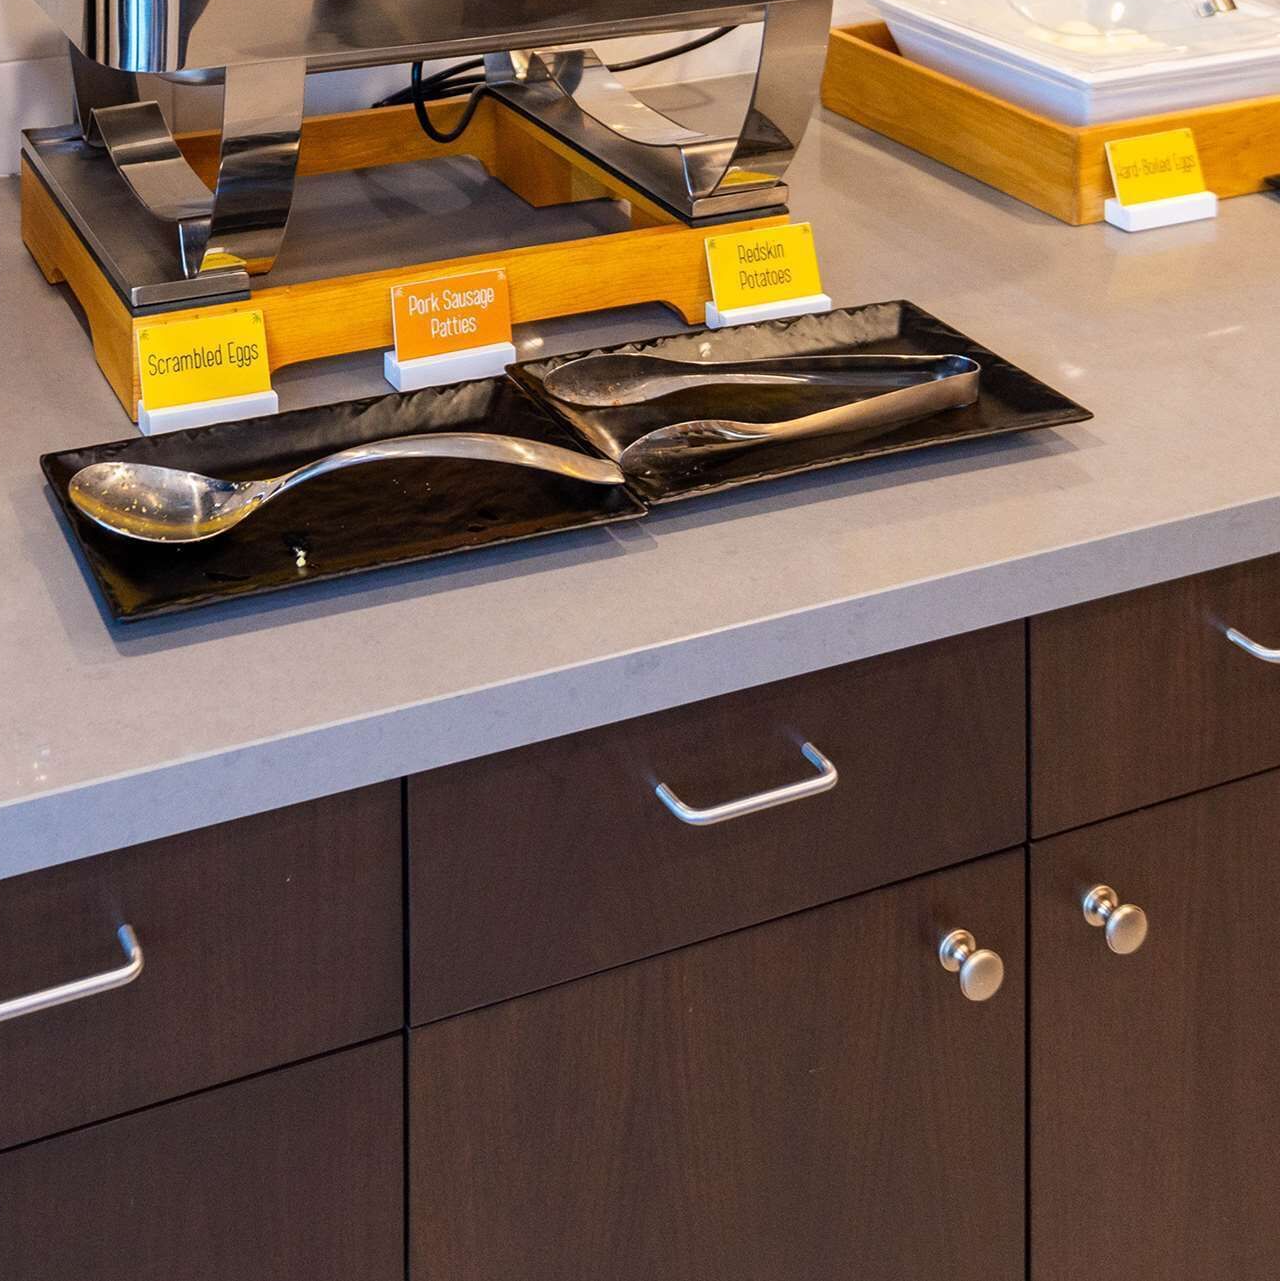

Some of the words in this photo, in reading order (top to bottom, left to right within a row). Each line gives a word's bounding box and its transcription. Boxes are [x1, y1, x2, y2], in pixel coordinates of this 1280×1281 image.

[737, 241, 785, 264] Redskin
[739, 268, 792, 290] Potatoes
[408, 293, 440, 316] Pork
[442, 287, 495, 309] Sausage
[431, 315, 477, 338] Patties
[147, 344, 223, 376] Scrambled
[227, 341, 259, 368] Eggs
